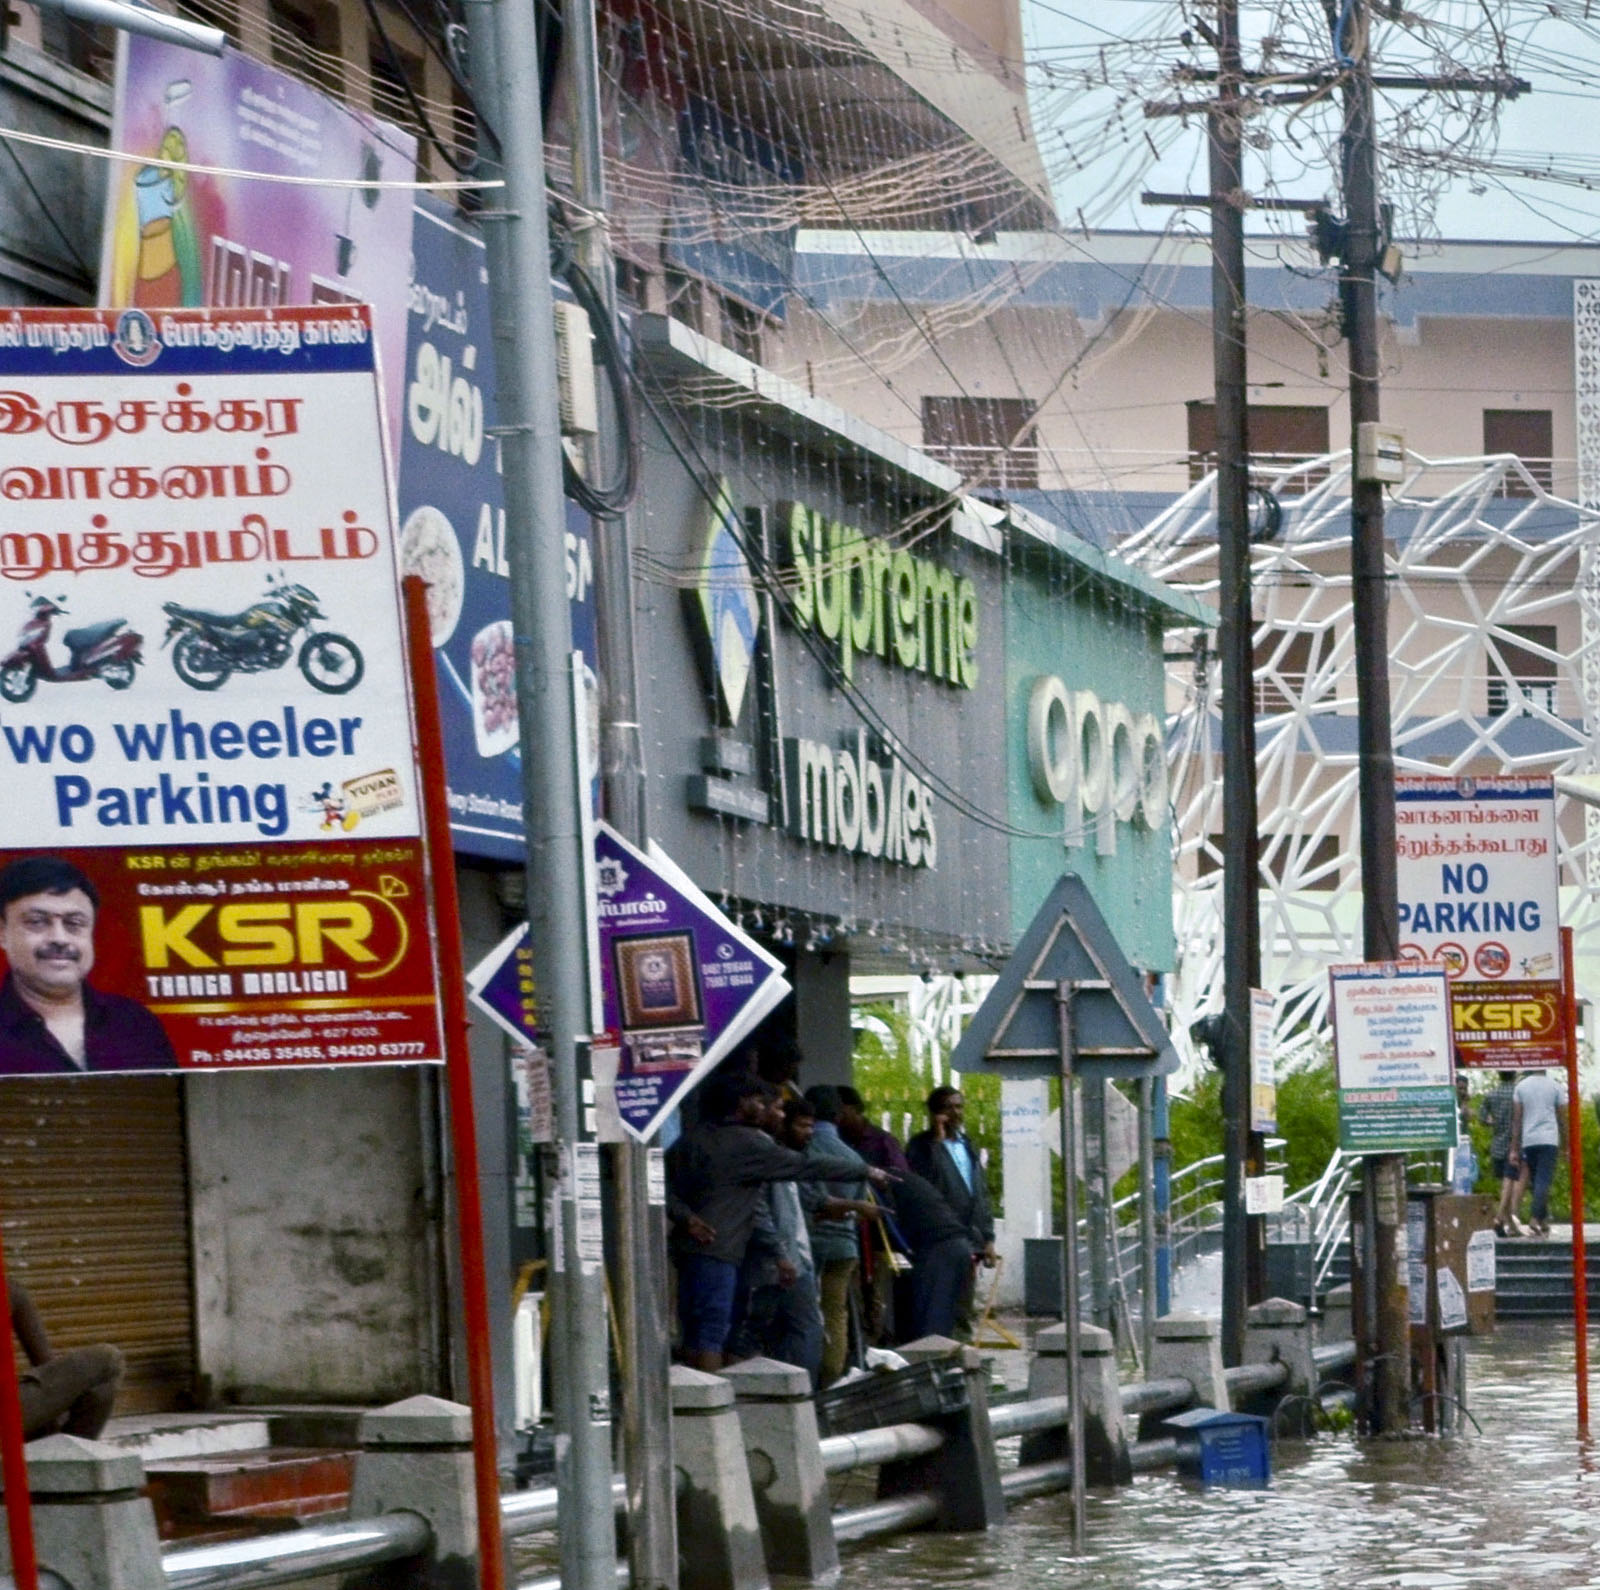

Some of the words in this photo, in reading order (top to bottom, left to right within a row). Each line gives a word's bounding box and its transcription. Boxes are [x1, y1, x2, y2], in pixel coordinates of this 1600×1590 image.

[0, 382, 303, 445] இருசக்கர
[1, 447, 291, 500] வாகனம்
[0, 510, 378, 581] றுத்துமிடம்
[0, 716, 95, 763] wo
[114, 706, 362, 761] wheeler
[1028, 674, 1168, 856] oppo
[54, 772, 289, 836] Parking
[798, 725, 938, 869] mobiles
[1442, 863, 1488, 894] NO
[140, 901, 380, 968] KSR
[1398, 901, 1540, 933] PARKING
[1454, 1003, 1542, 1029] KSR
[224, 1049, 271, 1062] 94436
[329, 1045, 376, 1057] 94420
[380, 1042, 425, 1055] 63777
